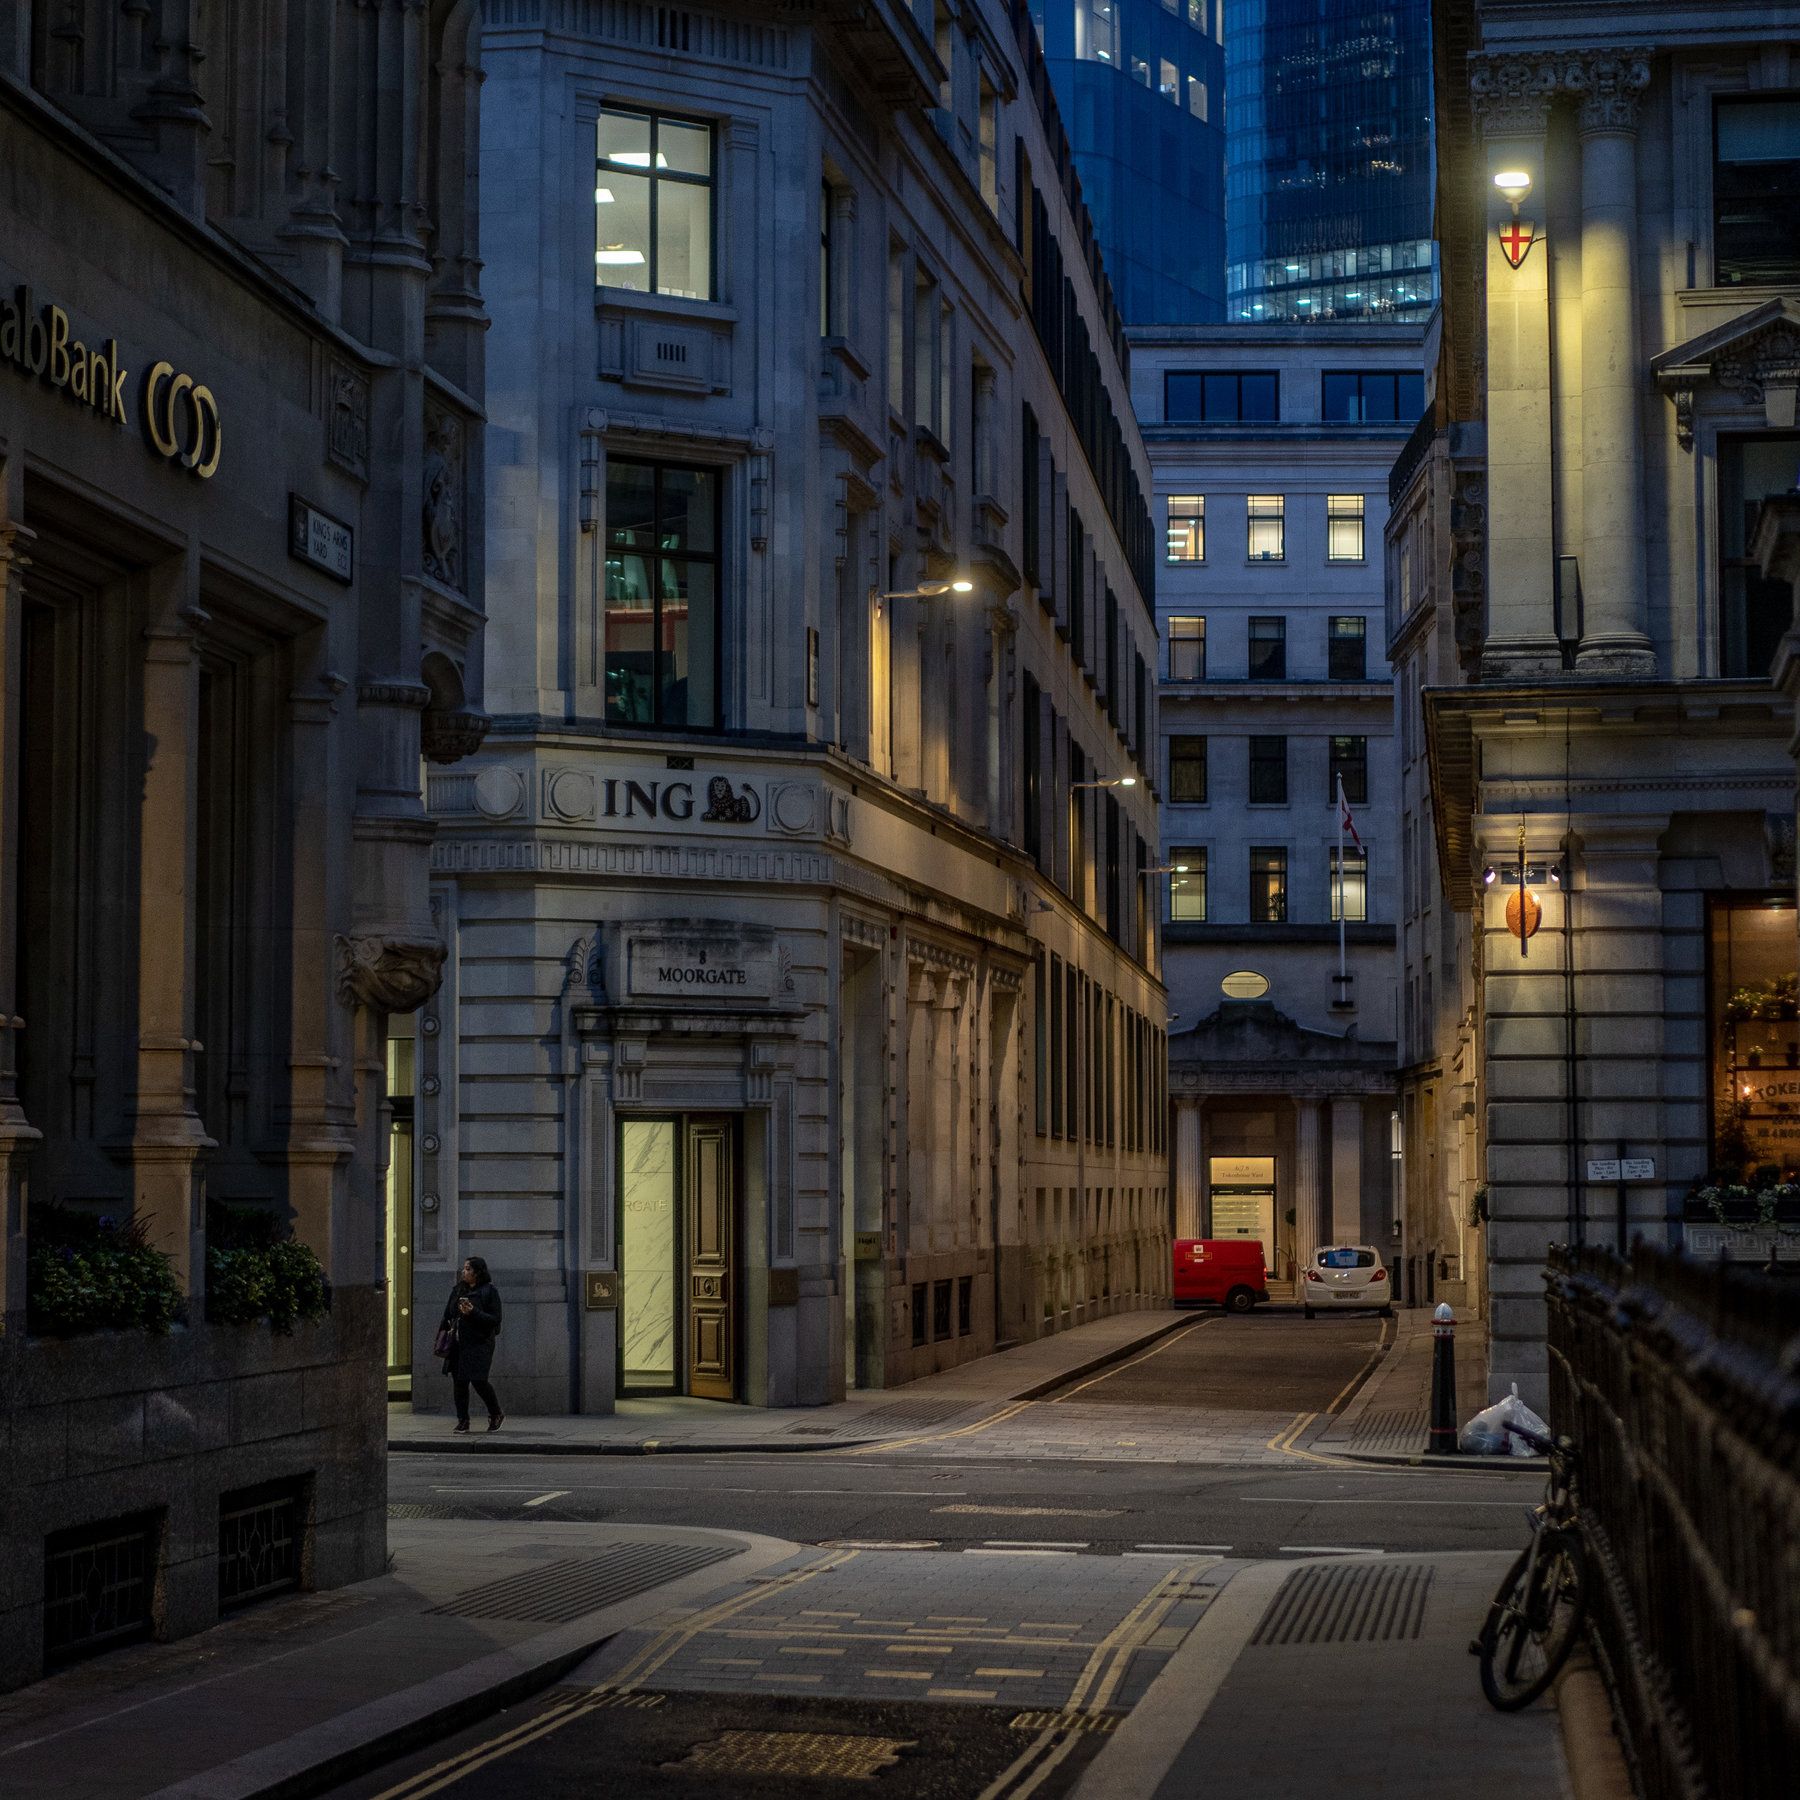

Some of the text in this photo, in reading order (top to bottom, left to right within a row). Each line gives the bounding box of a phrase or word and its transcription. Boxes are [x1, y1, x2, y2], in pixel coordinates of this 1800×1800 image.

[313, 537, 328, 559] YARD
[602, 779, 695, 820] ING
[699, 951, 706, 964] 8
[658, 967, 747, 984] MOORGATE
[1755, 1082, 1800, 1100] TOKE
